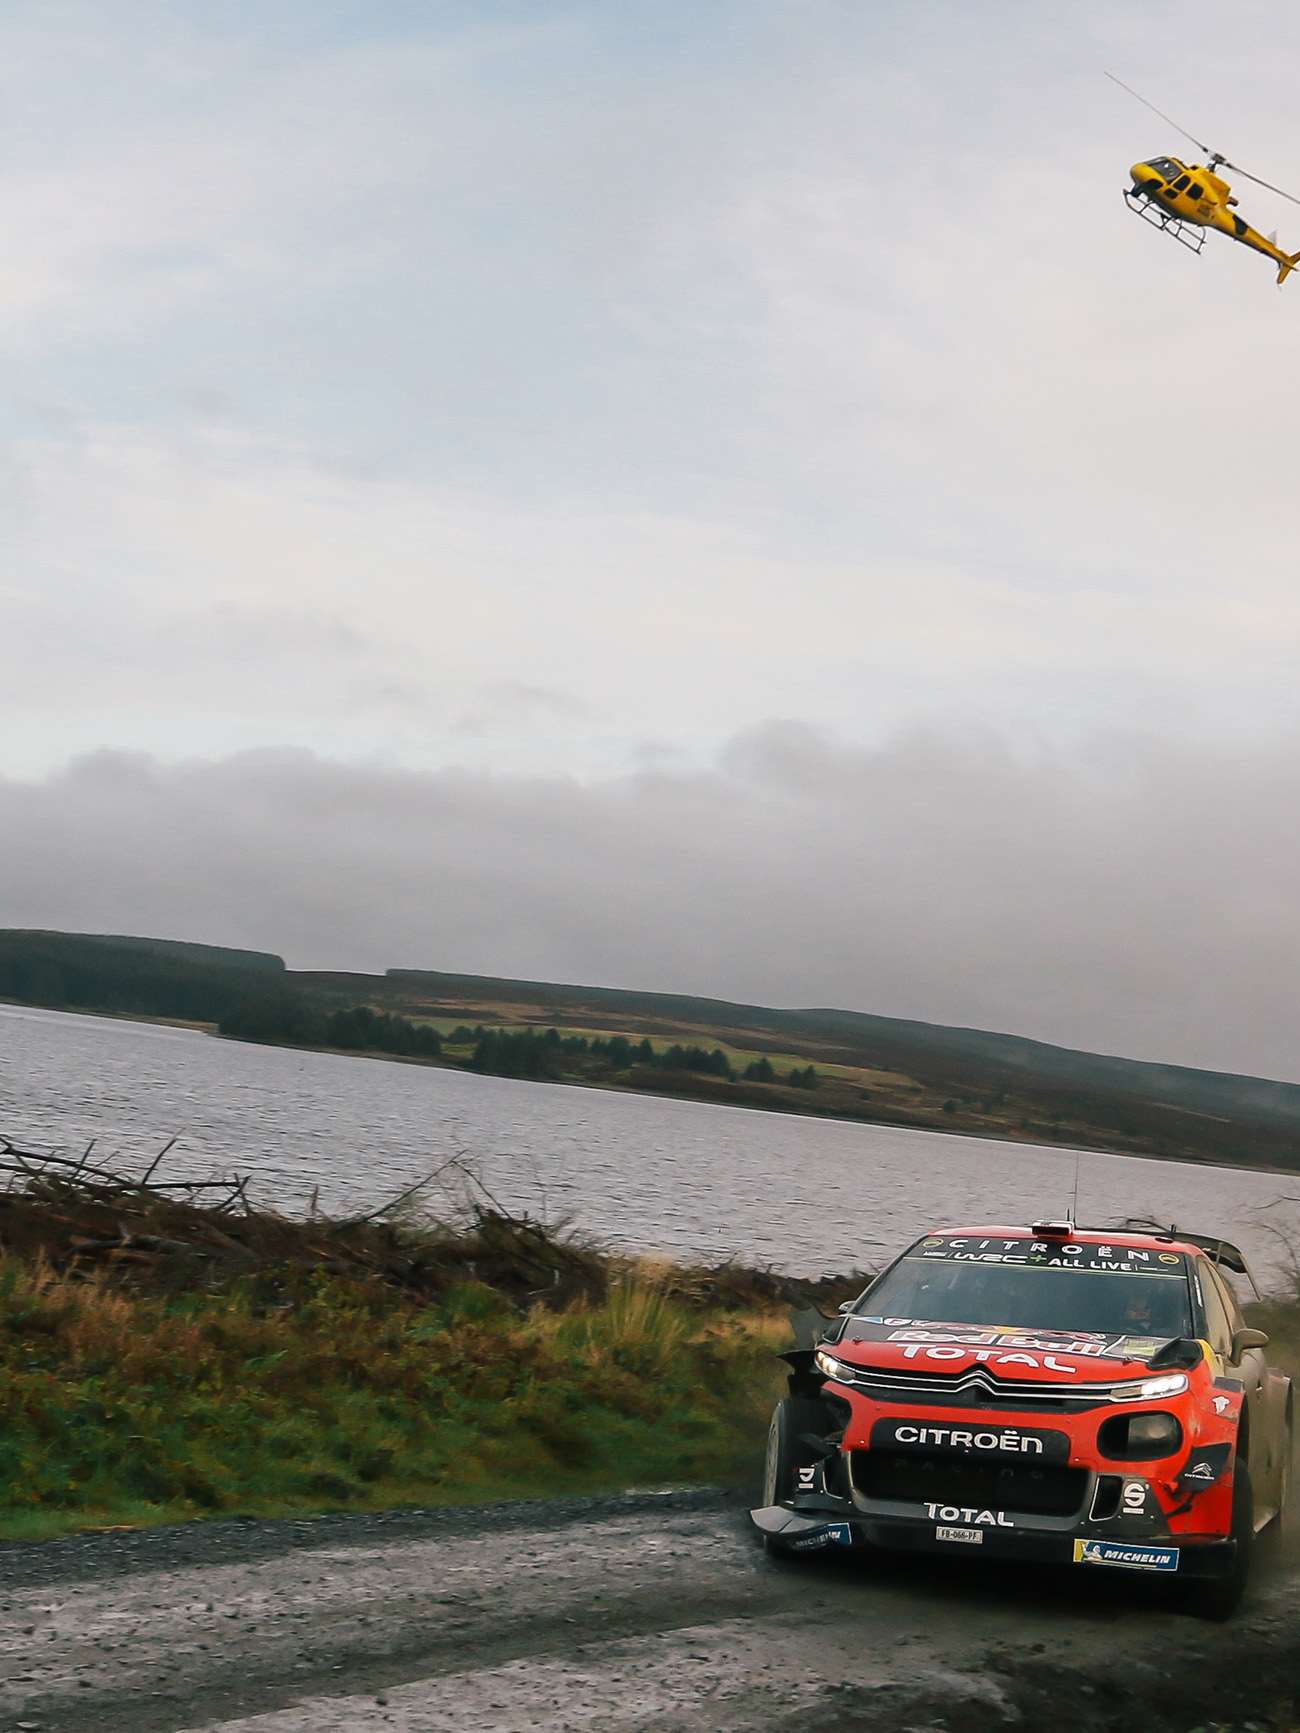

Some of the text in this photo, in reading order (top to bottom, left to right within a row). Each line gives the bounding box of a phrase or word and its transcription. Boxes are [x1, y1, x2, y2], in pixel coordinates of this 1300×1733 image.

[949, 1239, 1150, 1262] CITROËN
[1048, 1257, 1085, 1268] ALL
[1090, 1261, 1132, 1272] LIVE
[896, 1343, 1077, 1374] TOTAL
[923, 1502, 1015, 1528] TOTAL
[1103, 1550, 1171, 1564] MICHELIN
